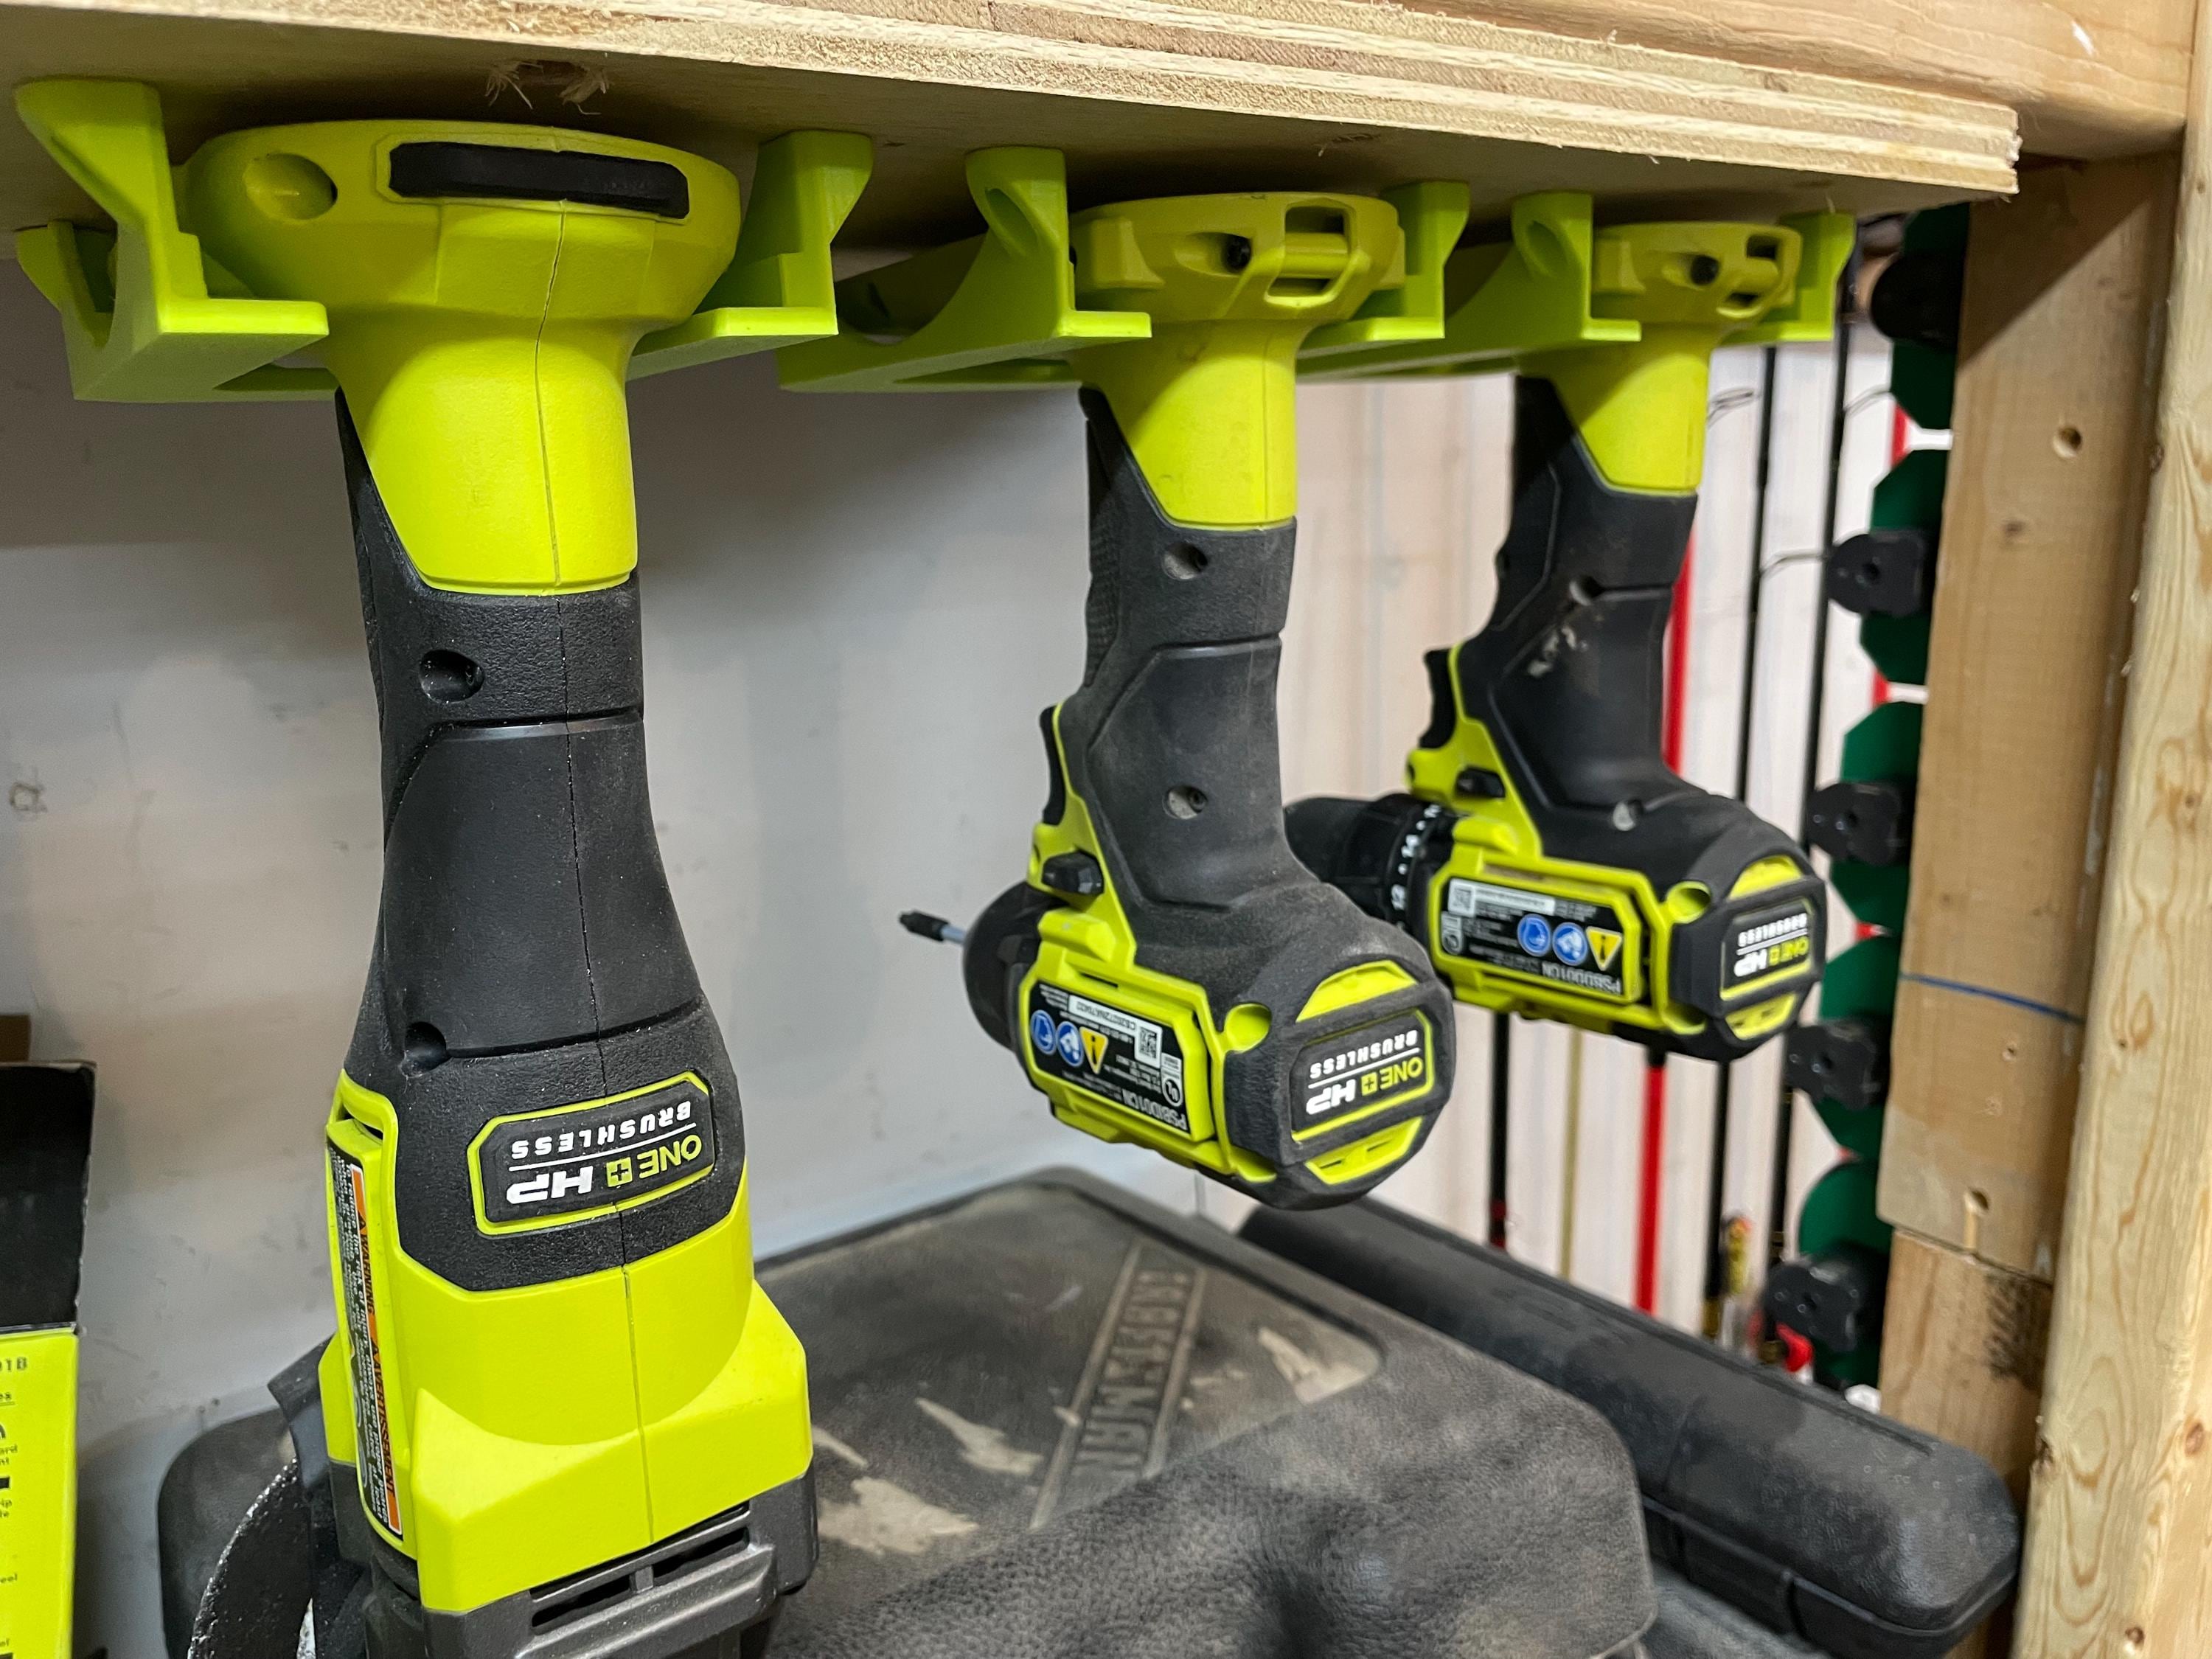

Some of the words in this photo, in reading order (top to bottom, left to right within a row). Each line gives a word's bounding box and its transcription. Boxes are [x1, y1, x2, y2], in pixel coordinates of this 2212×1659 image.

[1733, 949, 1767, 977] HP
[1310, 1030, 1418, 1079] BRUSHLESS
[1306, 1079, 1357, 1115] HP
[511, 1101, 692, 1159] BRUSHLESS
[347, 1182, 357, 1228] reduce
[507, 1166, 594, 1204] HP
[352, 1234, 361, 1255] the
[355, 1259, 363, 1284] risk
[360, 1232, 375, 1315] WARNING
[364, 1354, 375, 1400] always
[1069, 1270, 1187, 1484] CRAFTSMAN
[374, 1357, 394, 1497] AVERTISSEMENT
[372, 1431, 383, 1475] proper
[378, 1478, 388, 1523] guards
